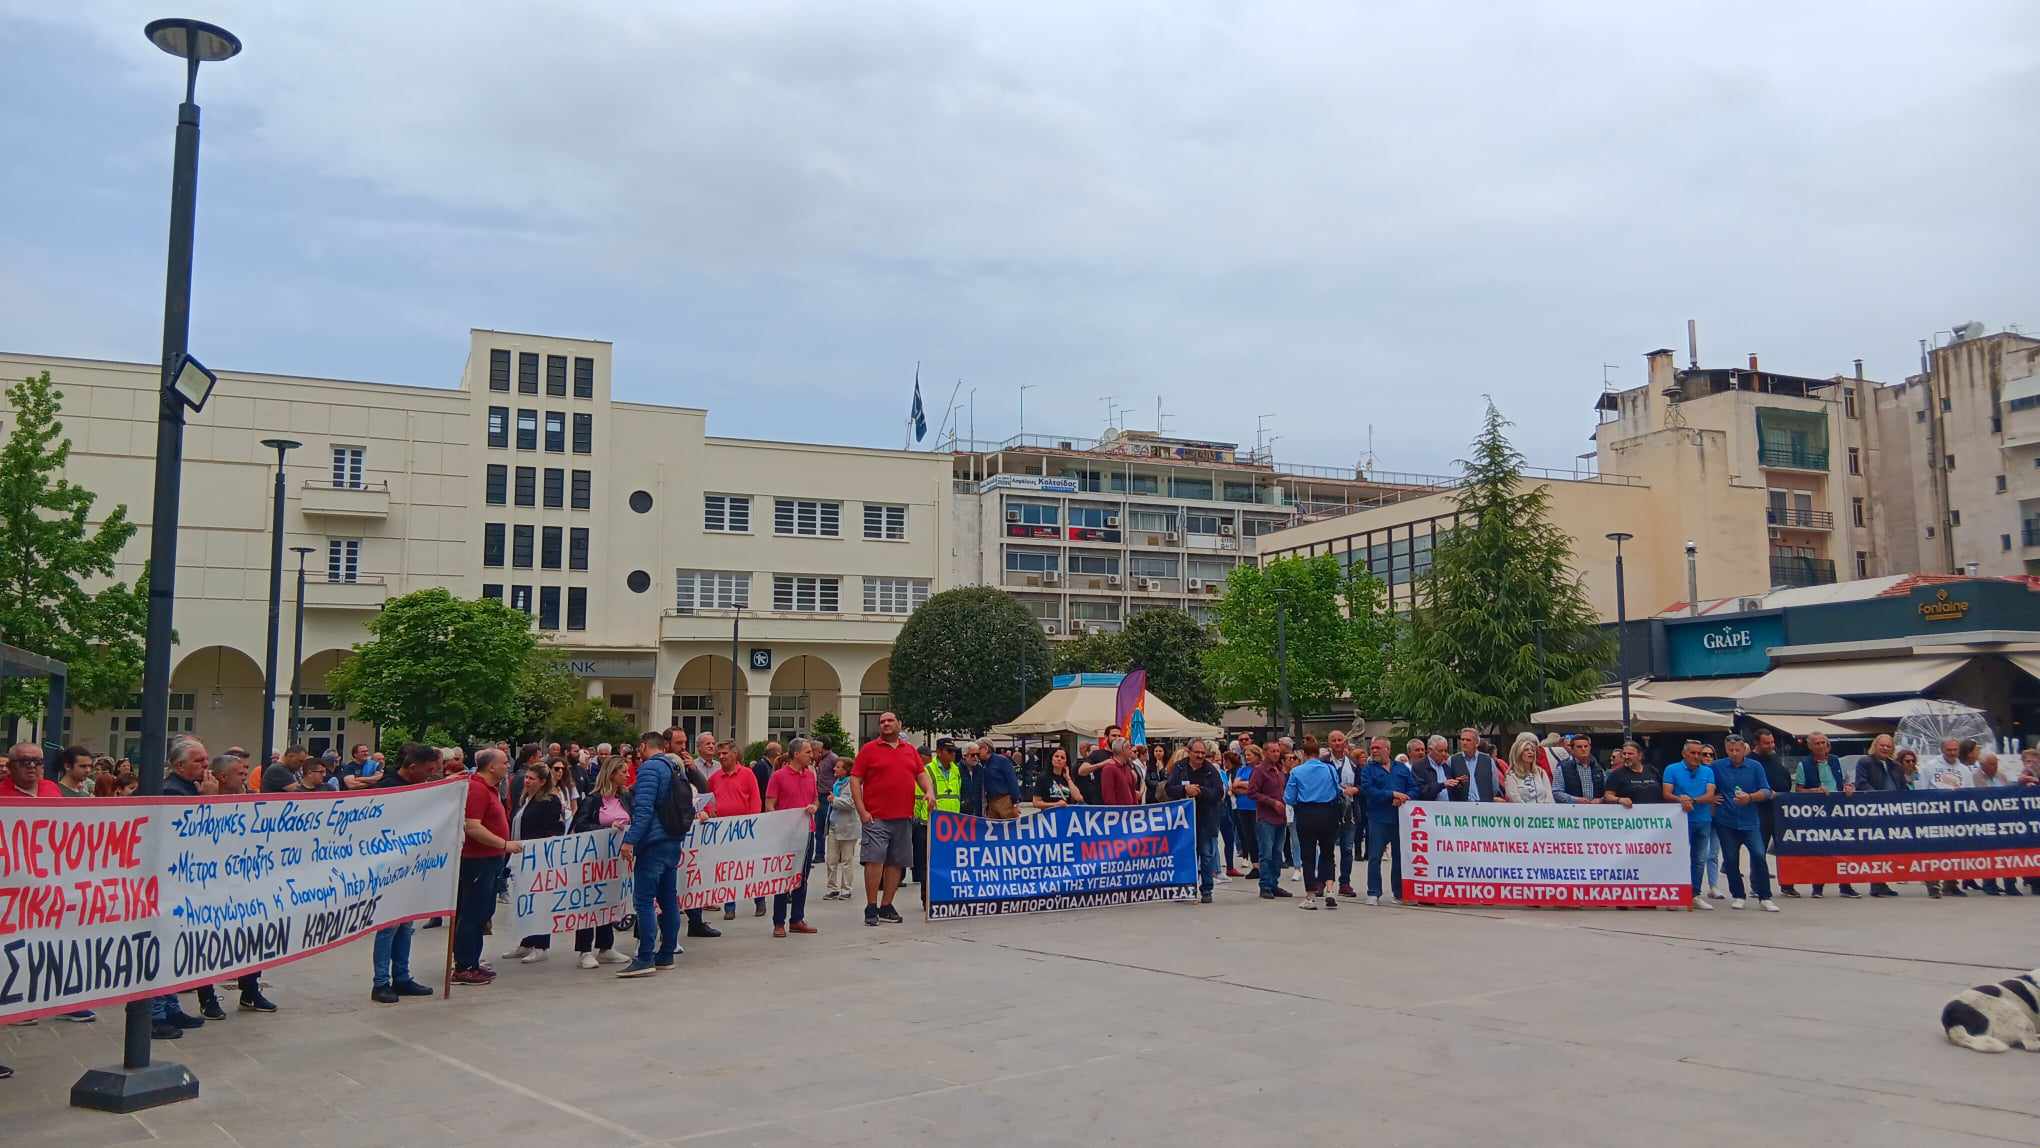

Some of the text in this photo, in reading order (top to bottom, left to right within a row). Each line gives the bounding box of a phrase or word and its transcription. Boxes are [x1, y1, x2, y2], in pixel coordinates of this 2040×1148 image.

[179, 799, 385, 845] Συλλογικές Συμβάσεις Εργασίας
[935, 804, 1190, 843] ΟΧΙ ΣΤΗΝ ΑΚΡΙΒΕΙΑ
[1434, 814, 1673, 831] ΓΙΑ ΝΑ ΓΙΝΟΥΝ ΟΙ ΖΩΕΣ ΜΑΣ ΠΡΟΤΕΡΑΙΟΤΗΤΑ
[1781, 804, 1827, 818] 100%
[1831, 801, 1951, 817] ΑΠΟΖΗΜΕΙΩΣΗ
[1954, 799, 1980, 814] ΓΙΑ
[1981, 797, 2020, 812] ΟΛΕΣ
[520, 843, 537, 873] Η
[543, 834, 598, 869] ΥΓΕΙΑ
[720, 816, 759, 846] ΛΑΟΥ
[1410, 805, 1429, 878] ΑΓΩΝΑΣ
[1436, 839, 1673, 855] ΓΙΑ ΠΡΑΓΜΑΤΙΚΕΣ ΑΥΞΗΣΕΙΣ ΣΤΟΥΣ ΜΙΣΘΟΥΣ
[1782, 828, 1856, 842] ΑΓΩΝΑΣ
[1858, 826, 1886, 841] ΓΙΑ
[1888, 825, 1913, 840] ΝΑ
[1915, 822, 1997, 839] ΜΕΙΝΟΥΜΕ
[1998, 820, 2027, 835] ΣΤΟ
[178, 828, 433, 889] Μέτρα στήριξης του λαϊκού εισοδήματος
[956, 835, 1170, 868] ΒΓΑΙΝΟΥΜΕ ΜΠΡΟΣΤΑ
[1836, 861, 1894, 876] ΕΟΑΣΚ
[1909, 856, 1992, 874] ΑΓΡΟΤΙΚΟΙ
[516, 893, 535, 918] ΟΙ
[550, 882, 608, 913] ΖΩΕΣ
[685, 868, 703, 889] ΤΑ
[713, 859, 755, 884] ΚΕΡΔΗ
[762, 852, 796, 875] ΤΟΥΣ
[529, 867, 569, 893] ΔΕΝ
[582, 858, 619, 886] ΕΙΝΑΙ
[951, 855, 1175, 883] ΓΙΑ ΤΗΝ ΠΡΟΣΤΑΣΙΑ ΤΟΥ ΕΙΣΟΔΗΜΑΤΟΣ
[951, 869, 1176, 898] ΤΗΣ ΔΟΥΛΕΙΑΣ ΚΑΙ ΤΗΣ ΥΓΕΙΑΣ ΤΟΥ ΛΑΟΥ
[1437, 865, 1640, 881] ΓΙΑ ΣΥΛΛΟΓΙΚΕΣ ΣΥΜΒΑΣΕΙΣ ΕΡΓΑΣΙΑΣ
[931, 886, 1197, 918] ΣΩΜΑΤΕΙΟ ΕΜΠΟΡΟΫΠΑΛΛΗΛΩΝ ΚΑΡΔΙΤΣΑΣ
[1413, 882, 1680, 901] ΕΡΓΑΤΙΚΟ ΚΕΝΤΡΟ Ν.ΚΑΡΔΙΤΣΑΣ
[185, 896, 269, 931] Αναγνώριση
[0, 894, 383, 1005] ΣΥΝΔΙΚΑΤΟ ΟΙΚΟΔΟΜΩΝ ΚΑΡΔΙΤΣΑΣ
